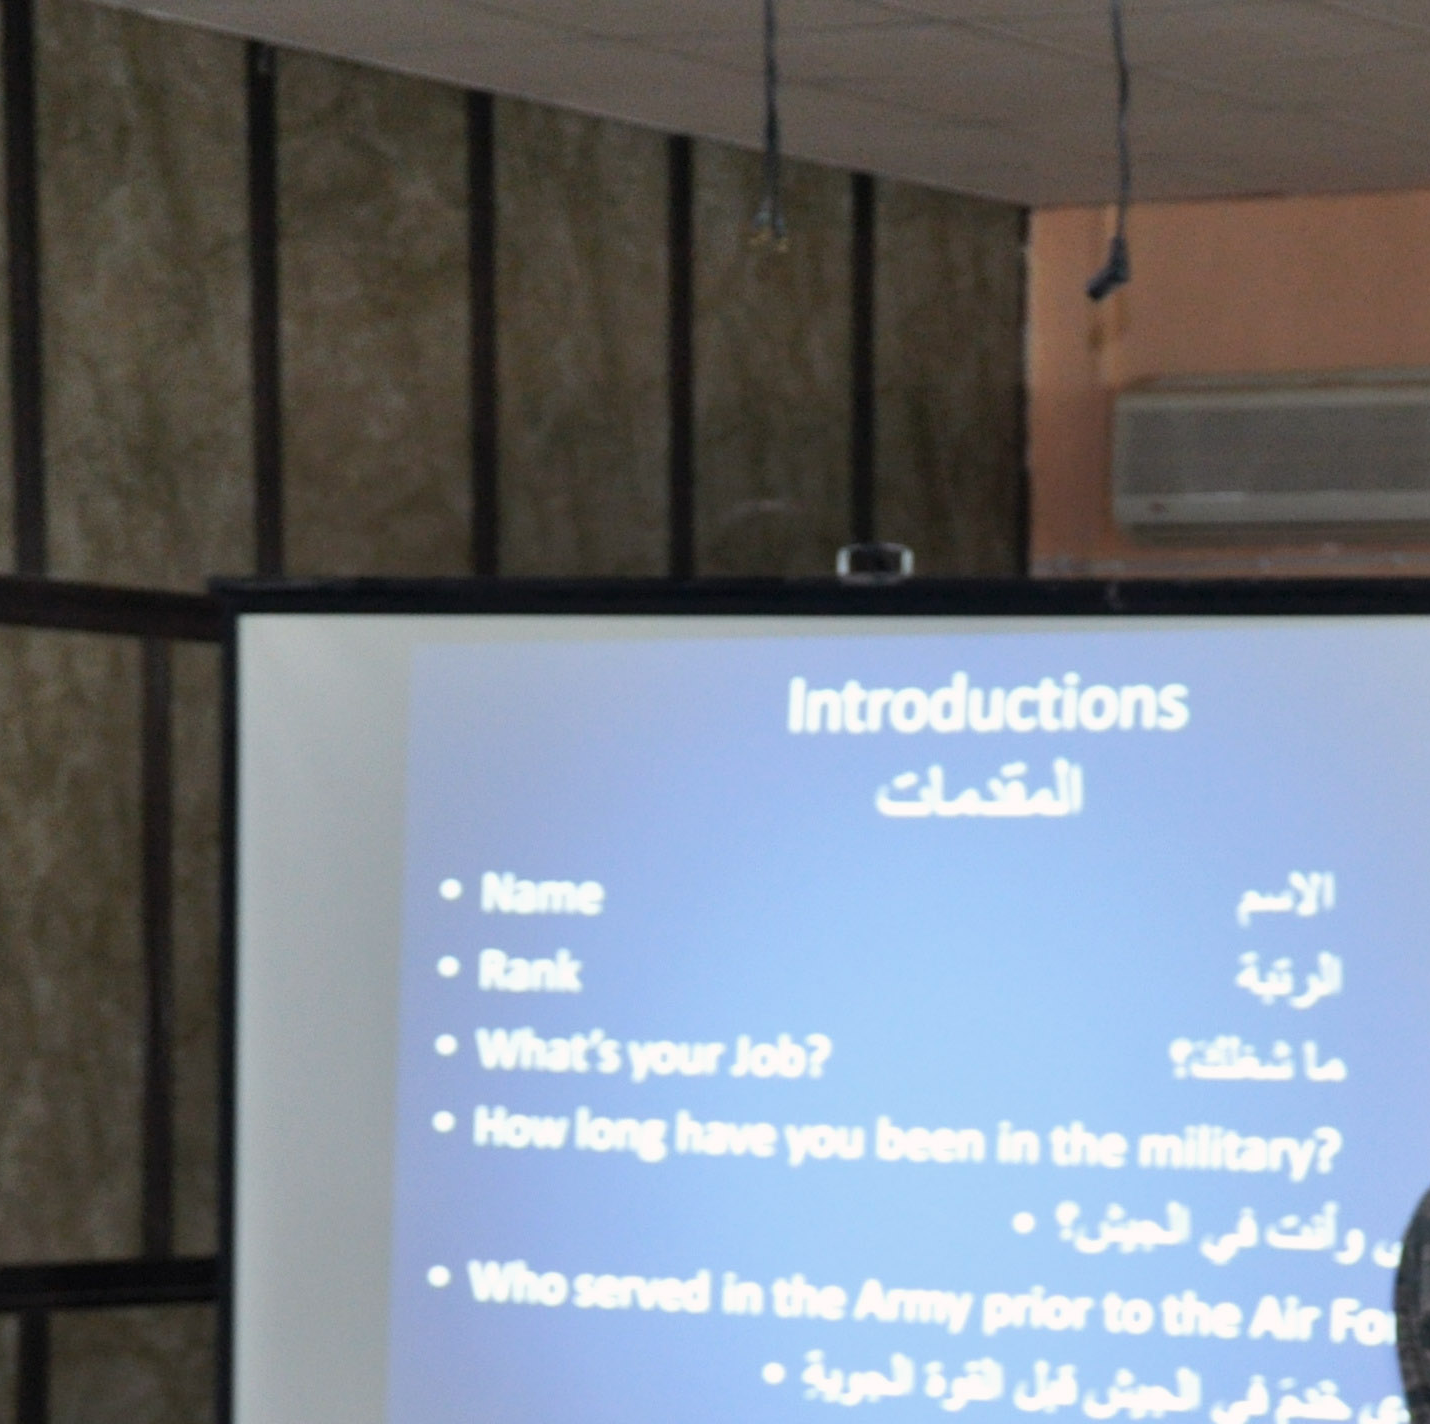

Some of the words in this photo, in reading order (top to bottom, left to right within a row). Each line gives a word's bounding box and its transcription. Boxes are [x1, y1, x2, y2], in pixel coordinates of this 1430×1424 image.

[788, 671, 1190, 734] Introductions
[481, 871, 605, 916] Name
[1236, 871, 1335, 927] الاسم
[479, 948, 582, 992] Rank
[1235, 951, 1342, 1010] الرتبة
[627, 1040, 727, 1083] your
[730, 1033, 833, 1079] Job?
[1302, 1039, 1348, 1082] ما
[474, 1105, 570, 1149] How
[574, 1107, 668, 1163] long
[674, 1109, 779, 1158] have
[784, 1124, 866, 1167] you
[875, 1115, 986, 1164] been
[996, 1120, 1041, 1165] in
[1049, 1121, 1129, 1169] the
[1137, 1124, 1343, 1182] military?
[468, 1259, 569, 1307] Who
[573, 1269, 712, 1314] served
[721, 1271, 765, 1315] in
[771, 1273, 848, 1321] the
[853, 1278, 974, 1334] Army
[982, 1285, 1095, 1336] prior
[1101, 1292, 1155, 1335] to
[1160, 1290, 1243, 1339] the
[1247, 1295, 1322, 1341] Air
[1013, 1360, 1079, 1414] قبل
[1082, 1367, 1202, 1420] الجيش
